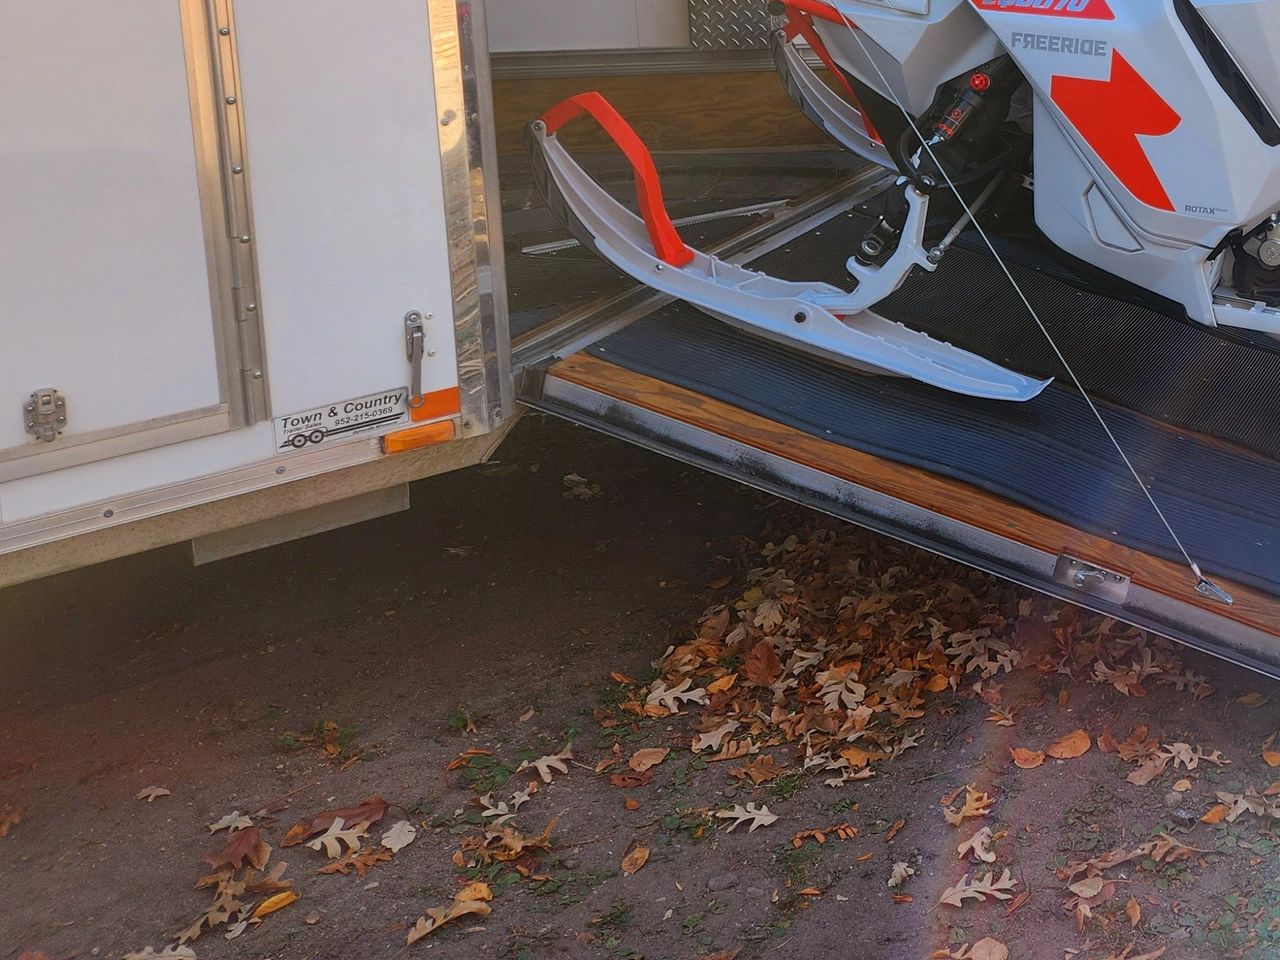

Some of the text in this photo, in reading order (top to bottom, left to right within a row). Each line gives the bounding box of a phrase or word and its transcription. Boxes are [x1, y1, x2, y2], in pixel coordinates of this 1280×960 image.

[1011, 32, 1108, 57] FREERIDE
[1184, 204, 1216, 215] ROTAX
[281, 392, 403, 429] Town & Country
[334, 406, 394, 427] 952-215-0369
